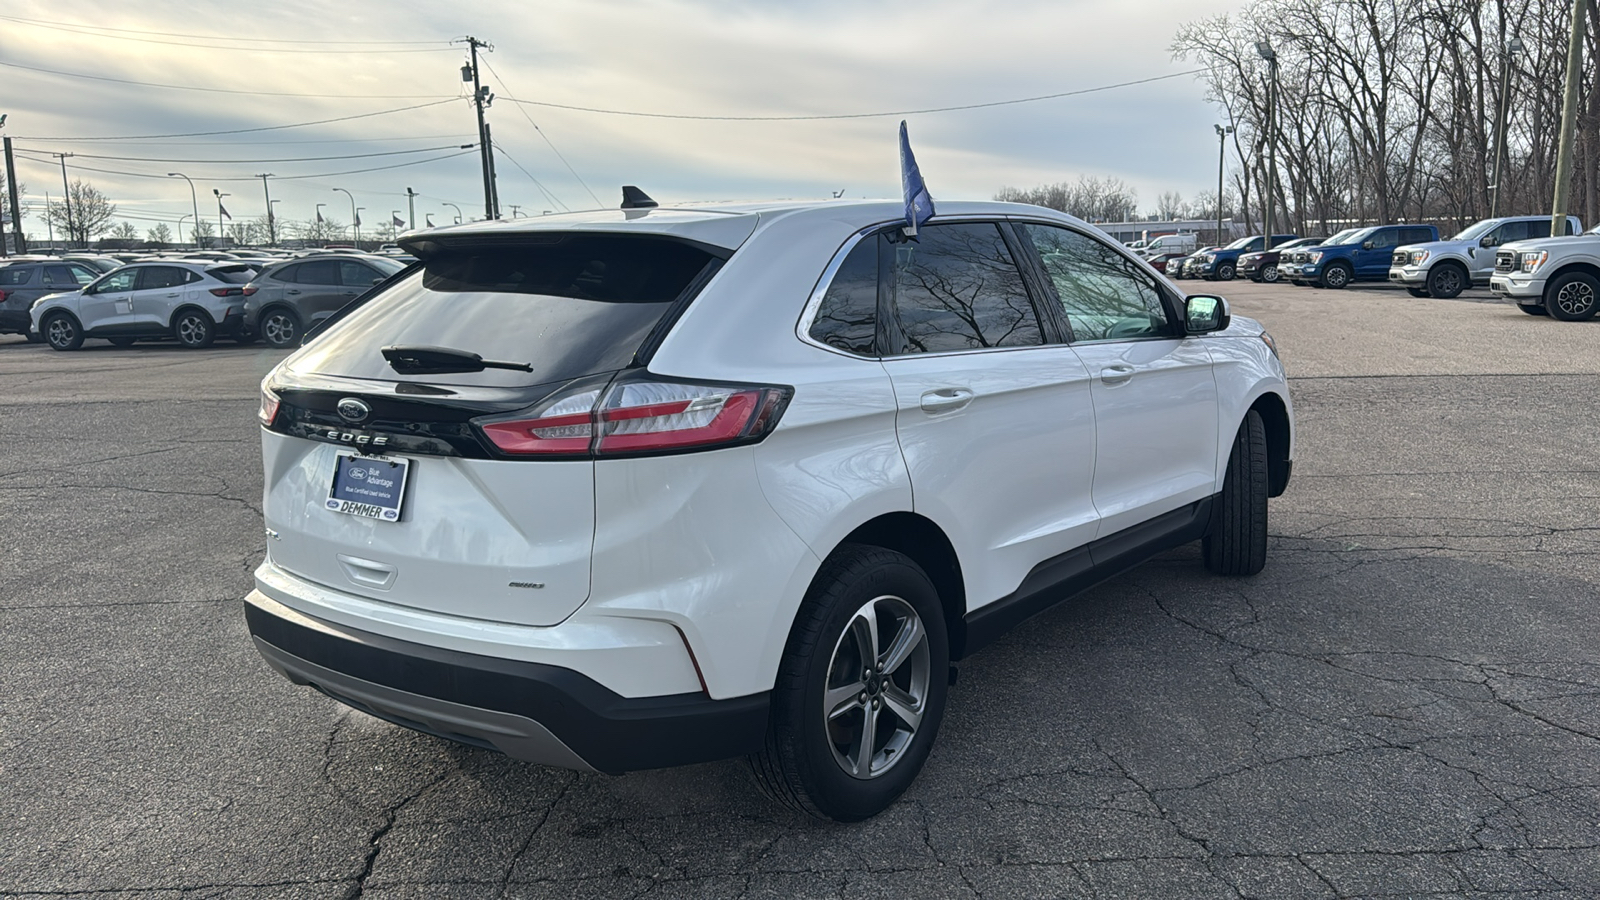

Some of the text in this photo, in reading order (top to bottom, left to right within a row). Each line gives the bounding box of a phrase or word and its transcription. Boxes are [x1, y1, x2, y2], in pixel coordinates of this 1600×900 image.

[327, 430, 389, 446] EDGE
[350, 468, 366, 478] Ford
[368, 467, 380, 477] Blue
[367, 476, 393, 488] Advantage
[354, 487, 369, 495] Certified
[340, 501, 383, 518] DEMMER
